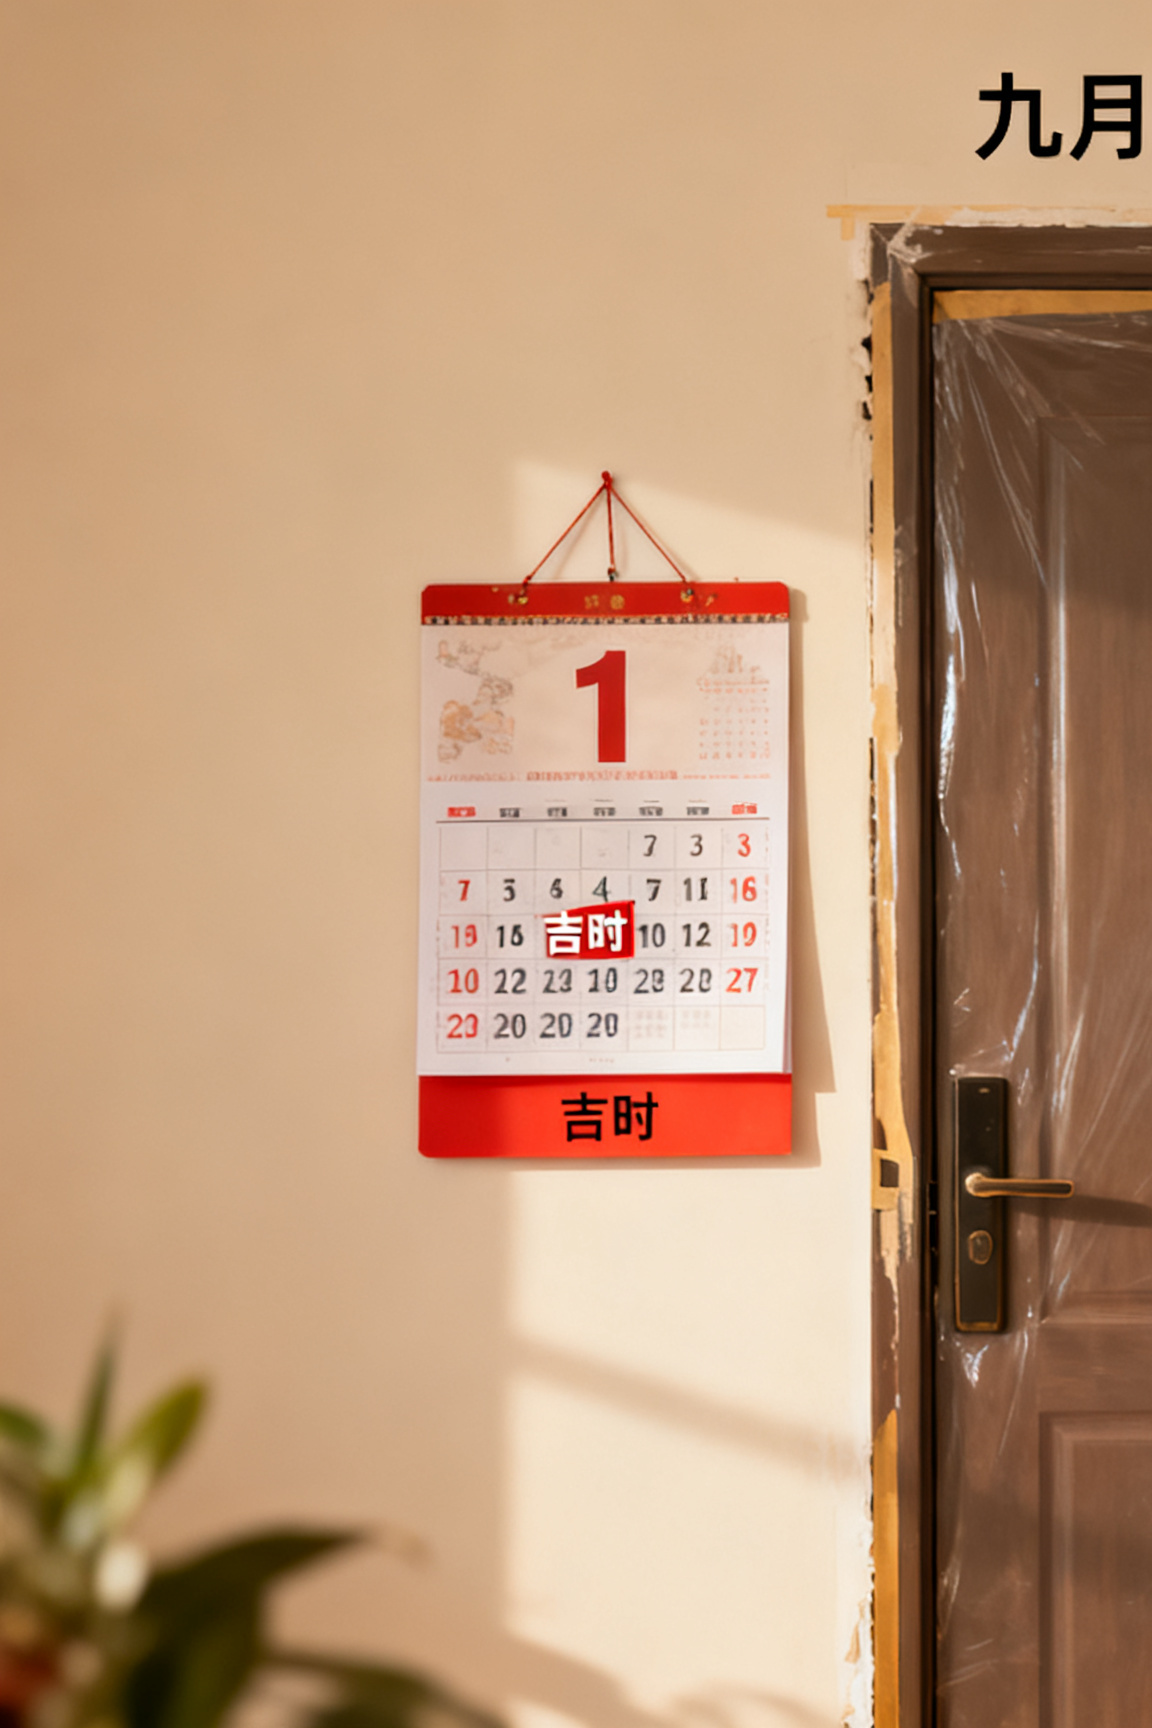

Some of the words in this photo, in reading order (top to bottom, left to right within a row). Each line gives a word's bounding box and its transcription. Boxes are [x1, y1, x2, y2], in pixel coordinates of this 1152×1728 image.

[575, 650, 626, 763] 1
[690, 834, 703, 857] 3
[738, 833, 751, 858] 3
[457, 880, 471, 901] 7
[544, 909, 628, 956] 吉时
[638, 923, 666, 948] 10
[682, 922, 711, 947] 12
[448, 968, 479, 994] 10
[494, 968, 527, 994] 22
[726, 968, 758, 993] 27
[494, 1013, 526, 1039] 20
[539, 1013, 573, 1039] 20
[586, 1012, 619, 1038] 20
[561, 1091, 659, 1142] 吉时
